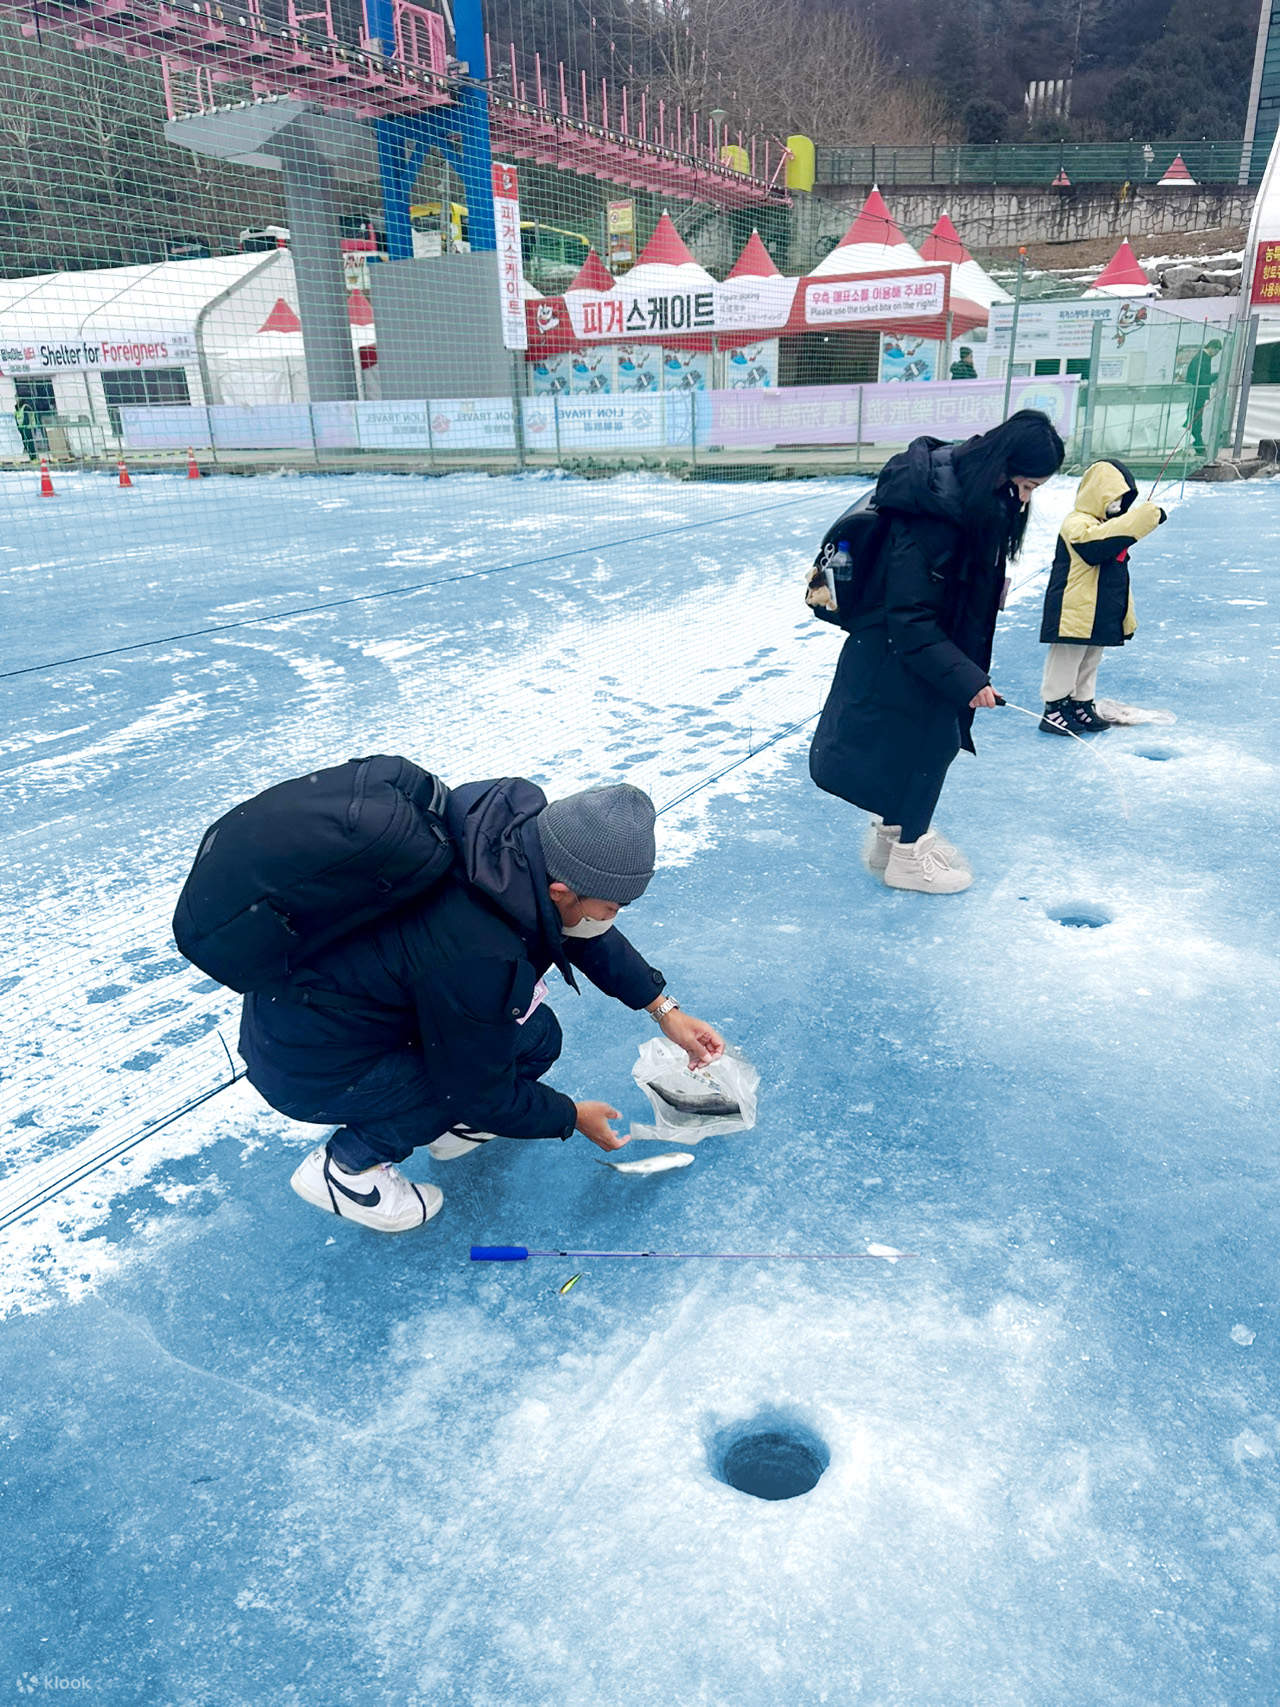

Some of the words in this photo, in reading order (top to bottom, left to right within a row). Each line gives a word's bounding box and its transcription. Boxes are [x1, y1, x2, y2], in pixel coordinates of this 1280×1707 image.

[501, 204, 521, 316] 피겨스케이트
[833, 288, 869, 303] 매표소를
[873, 285, 901, 300] 이용해
[905, 282, 937, 296] 주세요!
[582, 292, 715, 334] 피겨스케이트
[810, 305, 836, 317] Please
[847, 305, 858, 314] the
[859, 303, 879, 313] ticket
[880, 302, 891, 311] box
[903, 301, 914, 310] the
[40, 345, 81, 366] Shelter
[83, 342, 100, 365] for
[101, 341, 168, 367] Foreigners
